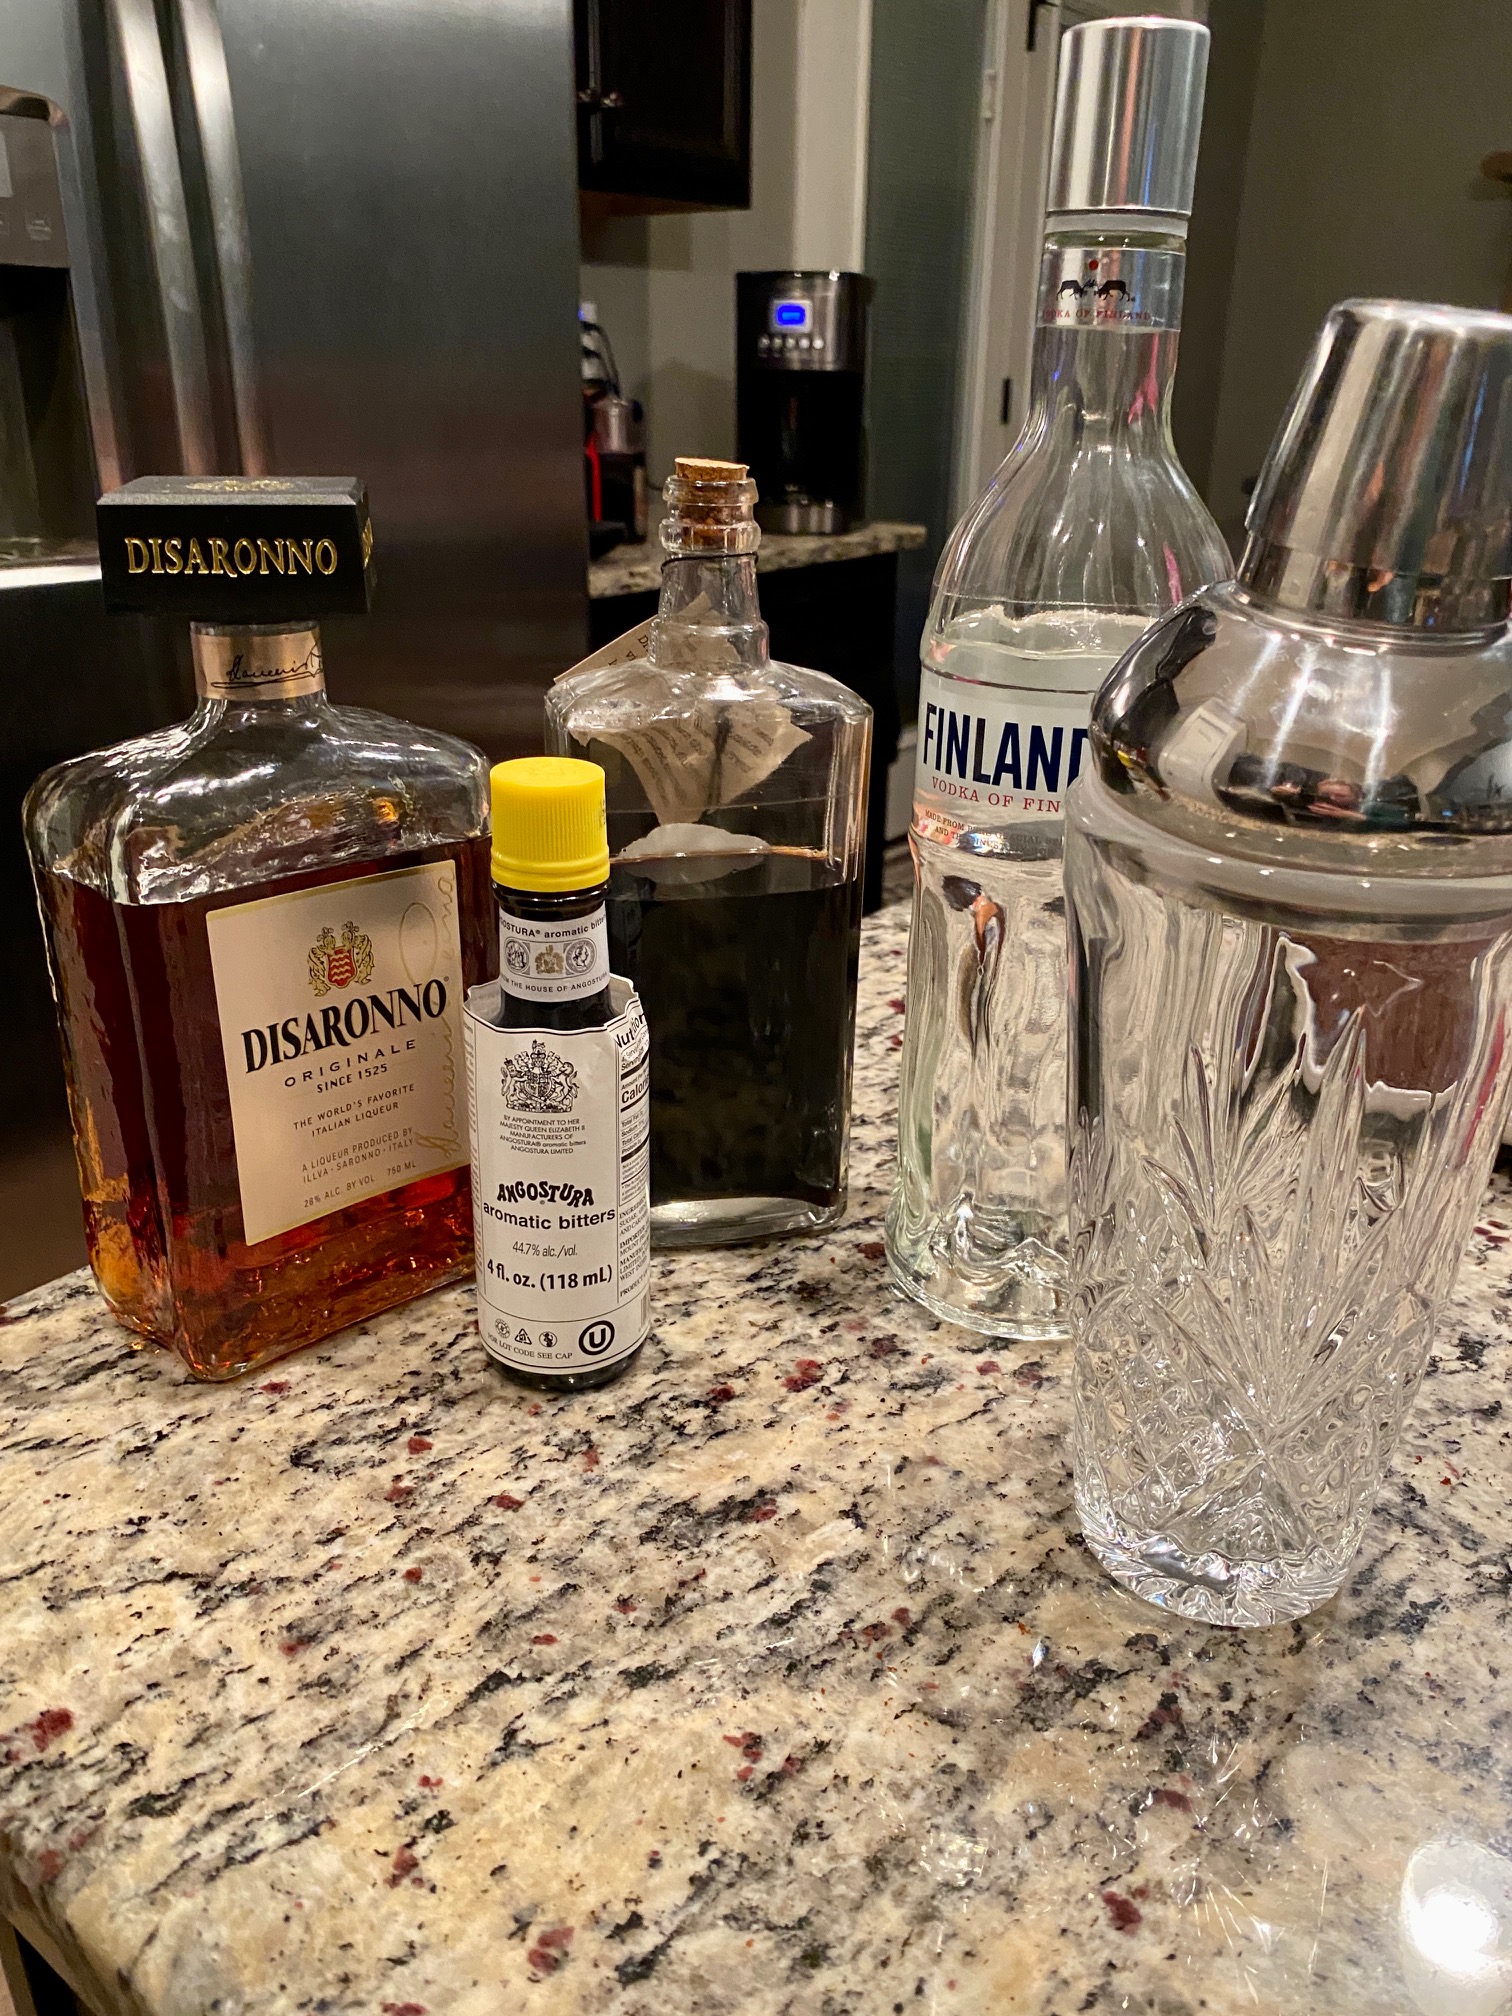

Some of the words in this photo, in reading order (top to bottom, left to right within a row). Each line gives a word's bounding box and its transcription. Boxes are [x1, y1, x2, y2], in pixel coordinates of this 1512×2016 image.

[1076, 309, 1089, 319] OF
[124, 537, 338, 577] DISARONNO
[932, 776, 980, 803] VODKA
[988, 793, 1014, 809] OF
[925, 809, 941, 823] MADE
[942, 818, 965, 831] FROM
[934, 826, 949, 837] AND
[544, 925, 589, 938] aromatic
[511, 980, 523, 989] THE
[241, 979, 447, 1074] DISARONNO
[284, 1039, 416, 1087] ORIGINALE
[317, 1074, 353, 1094] SINCE
[358, 1063, 388, 1081] 1525
[293, 1116, 313, 1131] THE
[317, 1099, 363, 1122] WORLD'S
[367, 1083, 415, 1105] FAVORITE
[311, 1117, 351, 1138] ITALIAN
[355, 1101, 400, 1122] LIQUEUR
[512, 1116, 555, 1126] APPOINTMENT
[500, 1121, 523, 1131] MAJESTY
[524, 1125, 547, 1133] QUEEN
[548, 1125, 580, 1134] ELIZABETH
[510, 1130, 563, 1140] MANUFACTURERS
[302, 1164, 308, 1172] A
[311, 1147, 349, 1170] LIQUEUR
[352, 1131, 399, 1154] PRODUCED
[402, 1127, 414, 1138] BY
[303, 1168, 329, 1184] ILLVA
[336, 1148, 381, 1172] SARONNO
[389, 1138, 414, 1152] ITALY
[510, 1145, 549, 1155] ANGOSTURA
[304, 1194, 321, 1208] 28%
[346, 1180, 358, 1192] BY
[387, 1164, 402, 1176] 750
[404, 1160, 417, 1171] ML
[497, 1180, 595, 1208] ANGOSTURA
[483, 1202, 552, 1230] aromatic
[559, 1207, 616, 1230] bitters
[512, 1241, 540, 1256] 44.7%
[542, 1244, 578, 1259] alc./vol.
[487, 1259, 494, 1275] 4
[496, 1263, 510, 1282] fl.
[513, 1273, 536, 1288] oz.
[540, 1273, 578, 1292] (118
[583, 1264, 613, 1287] mL)
[499, 1339, 513, 1352] LOT
[513, 1346, 535, 1358] CODE
[537, 1352, 553, 1360] SEE
[555, 1352, 573, 1360] CAP
